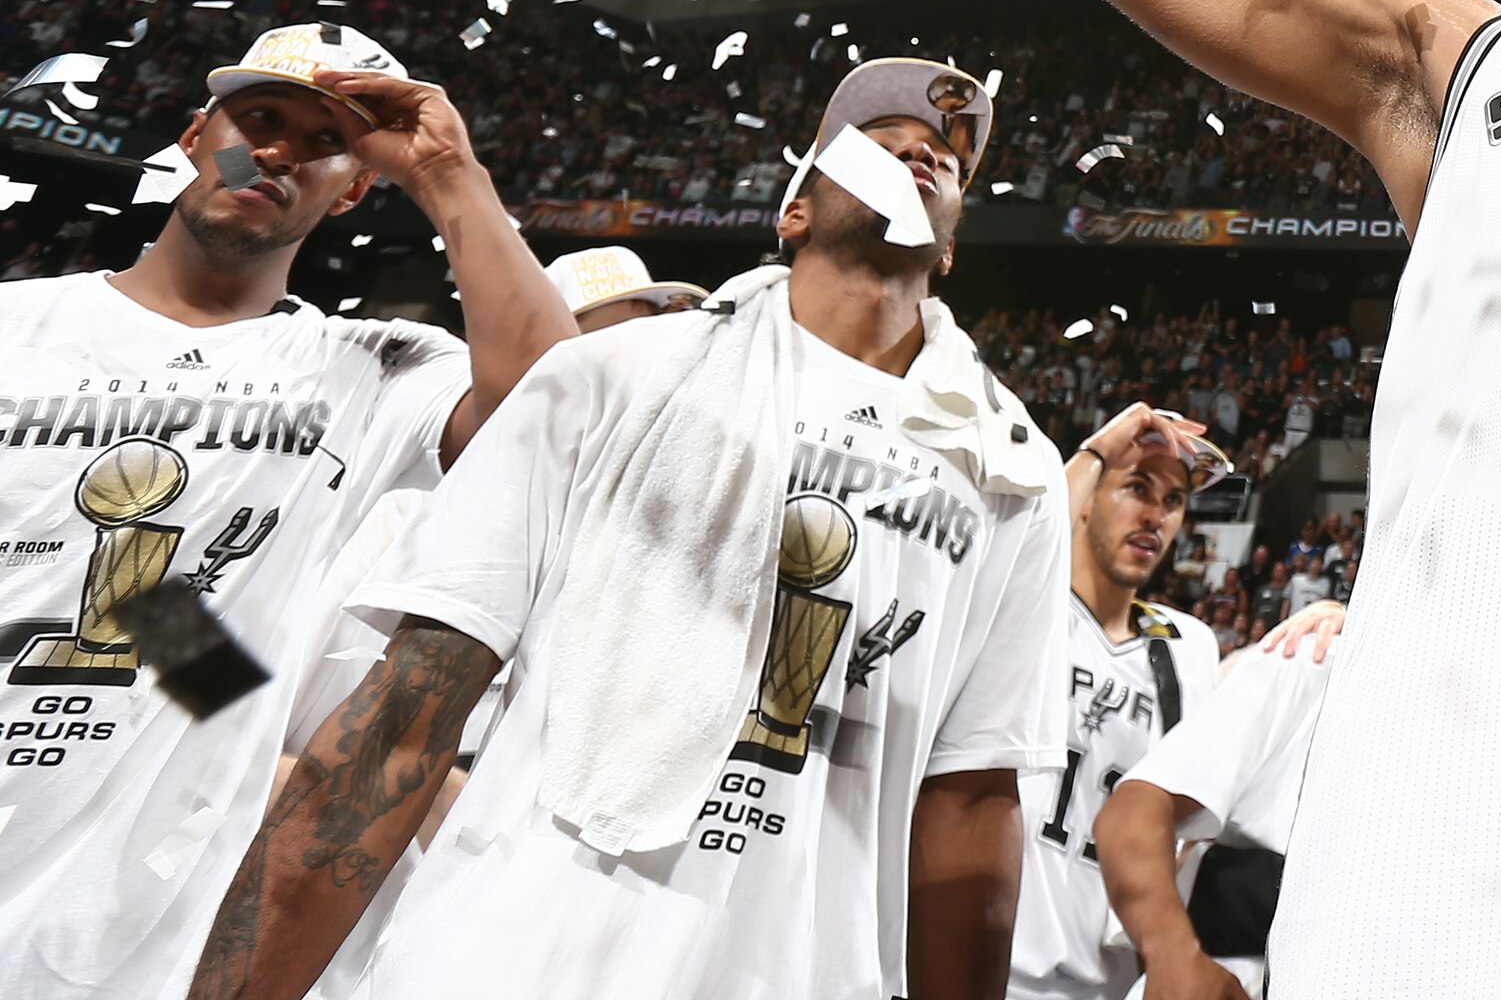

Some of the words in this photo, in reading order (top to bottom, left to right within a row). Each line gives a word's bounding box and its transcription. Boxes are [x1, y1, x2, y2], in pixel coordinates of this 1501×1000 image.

[0, 108, 123, 155] PION
[628, 206, 781, 228] CHAMPI
[78, 378, 179, 394] 2014
[215, 380, 280, 396] NBA
[844, 412, 884, 430] adidas
[887, 446, 939, 481] NBA
[13, 541, 65, 553] ROOM
[31, 696, 93, 714] GO
[7, 748, 67, 766] GO
[719, 773, 766, 799] GO
[1037, 745, 1128, 867] 1
[699, 829, 747, 856] GO
